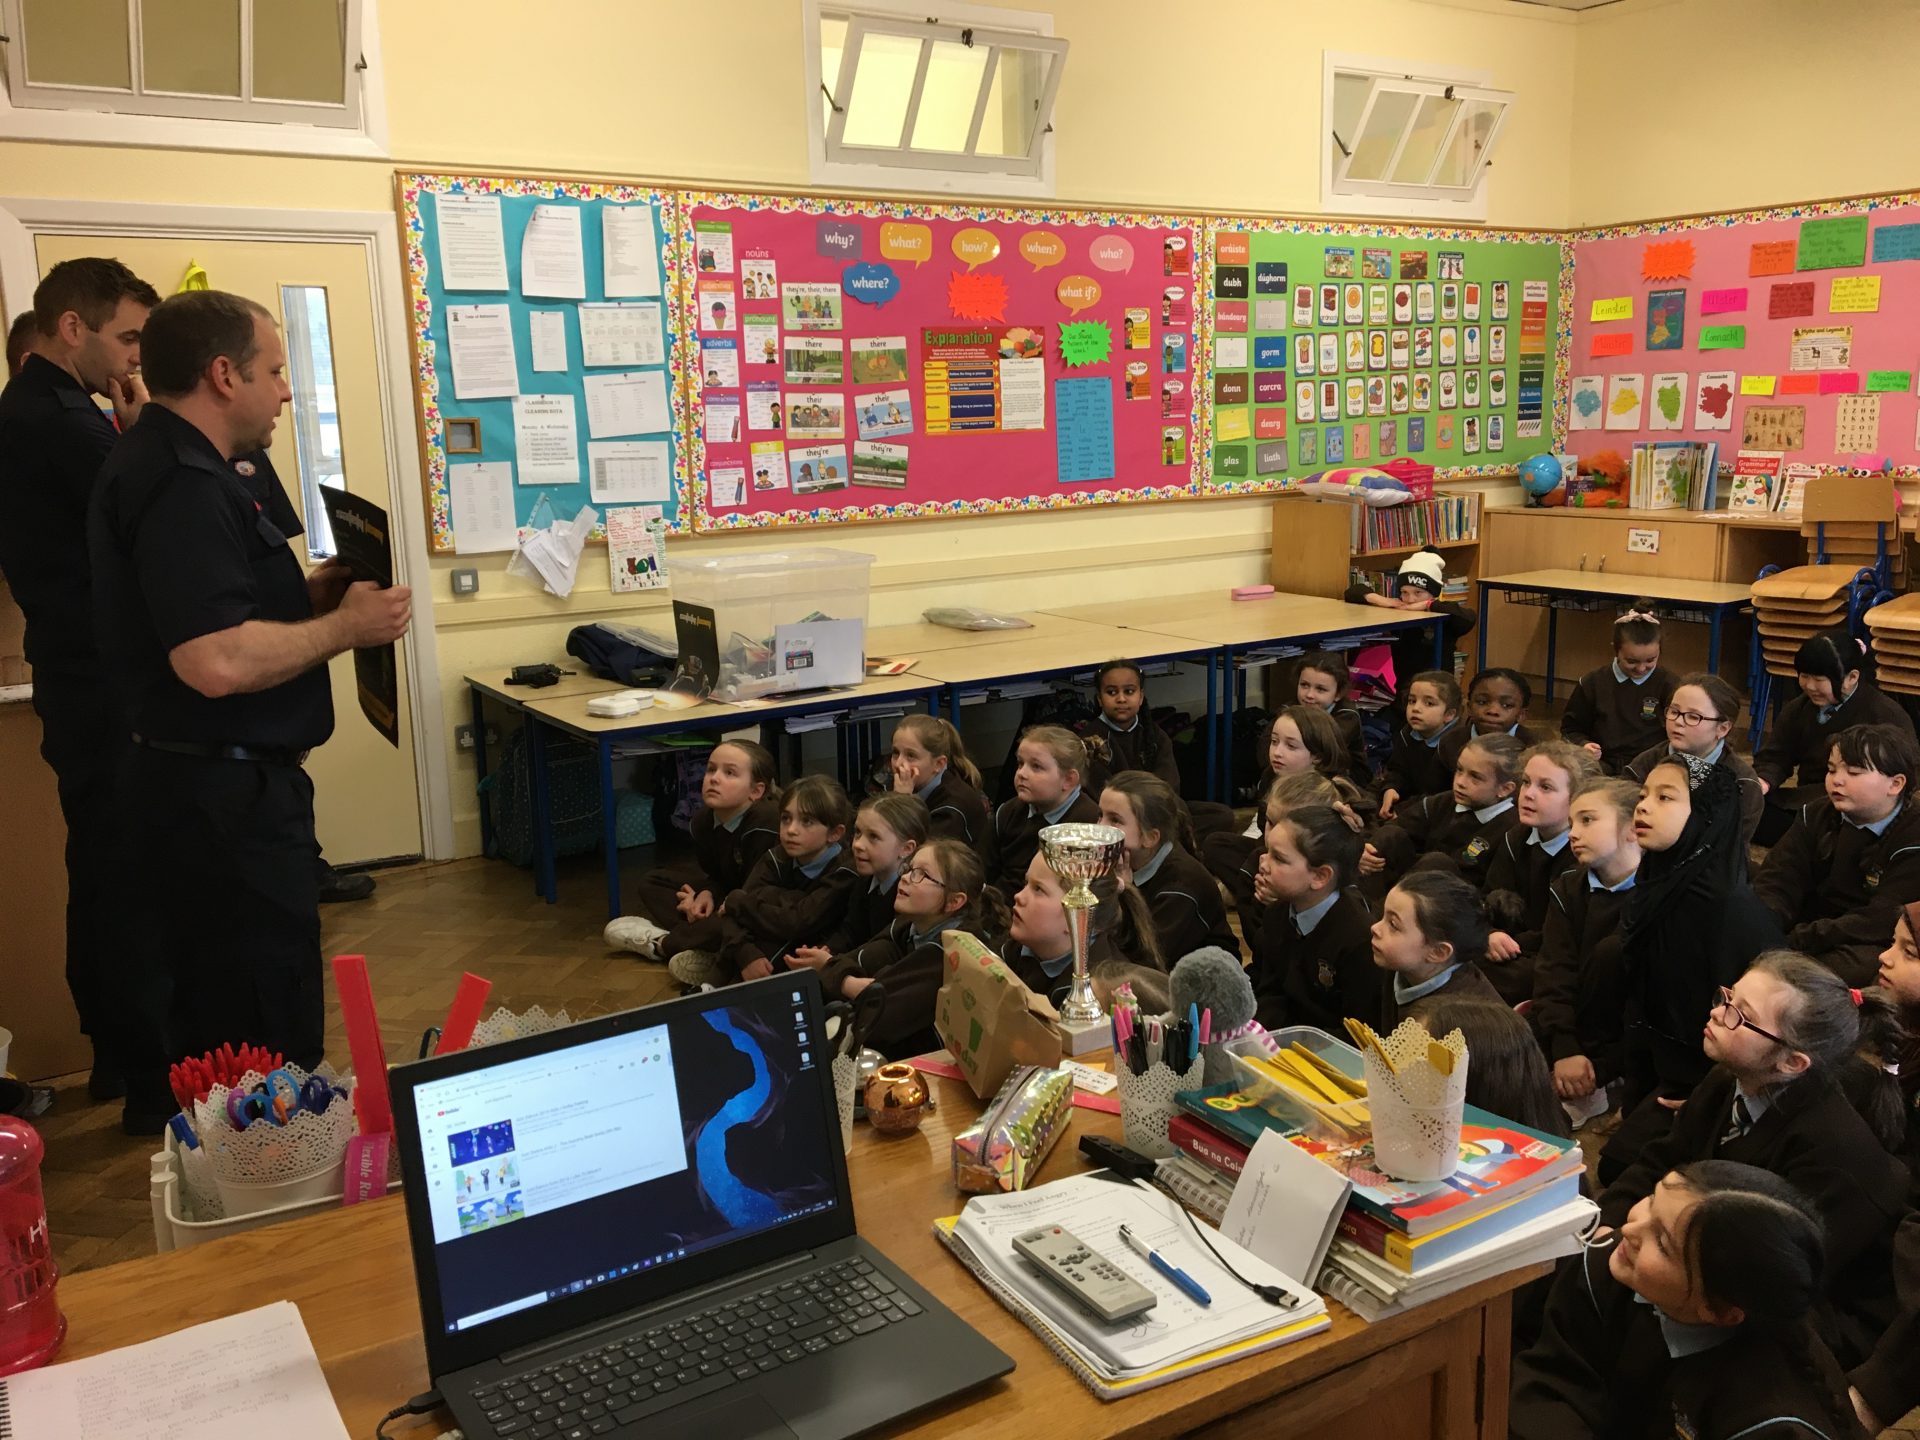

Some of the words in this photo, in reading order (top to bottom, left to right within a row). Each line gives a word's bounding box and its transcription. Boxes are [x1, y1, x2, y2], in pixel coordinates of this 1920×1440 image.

[825, 232, 854, 248] why?
[889, 236, 922, 248] what?
[962, 240, 987, 253] how?
[1026, 242, 1057, 254] when?
[745, 249, 769, 258] nouns
[1100, 249, 1123, 259] who?
[852, 277, 889, 289] where?
[1223, 277, 1242, 287] dubh
[1060, 286, 1082, 298] what
[1085, 286, 1097, 300] if?
[1596, 302, 1627, 316] Leinster
[925, 330, 993, 346] Explanation
[706, 340, 732, 348] adverbs
[805, 340, 823, 348] there
[870, 340, 887, 348] there
[1262, 349, 1280, 359] gorm
[1223, 384, 1241, 393] donn
[1259, 383, 1282, 392] corcra
[875, 394, 890, 403] their
[1261, 418, 1280, 430] dearg
[806, 447, 829, 456] they're
[870, 443, 893, 453] they're
[1224, 456, 1239, 467] glas
[1264, 452, 1280, 463] liath
[1740, 466, 1774, 474] Punctuation
[1408, 575, 1427, 586] WAC
[1192, 1138, 1209, 1157] Bua
[1211, 1150, 1222, 1163] na
[1001, 1199, 1024, 1211] When
[1045, 1190, 1068, 1202] Angry
